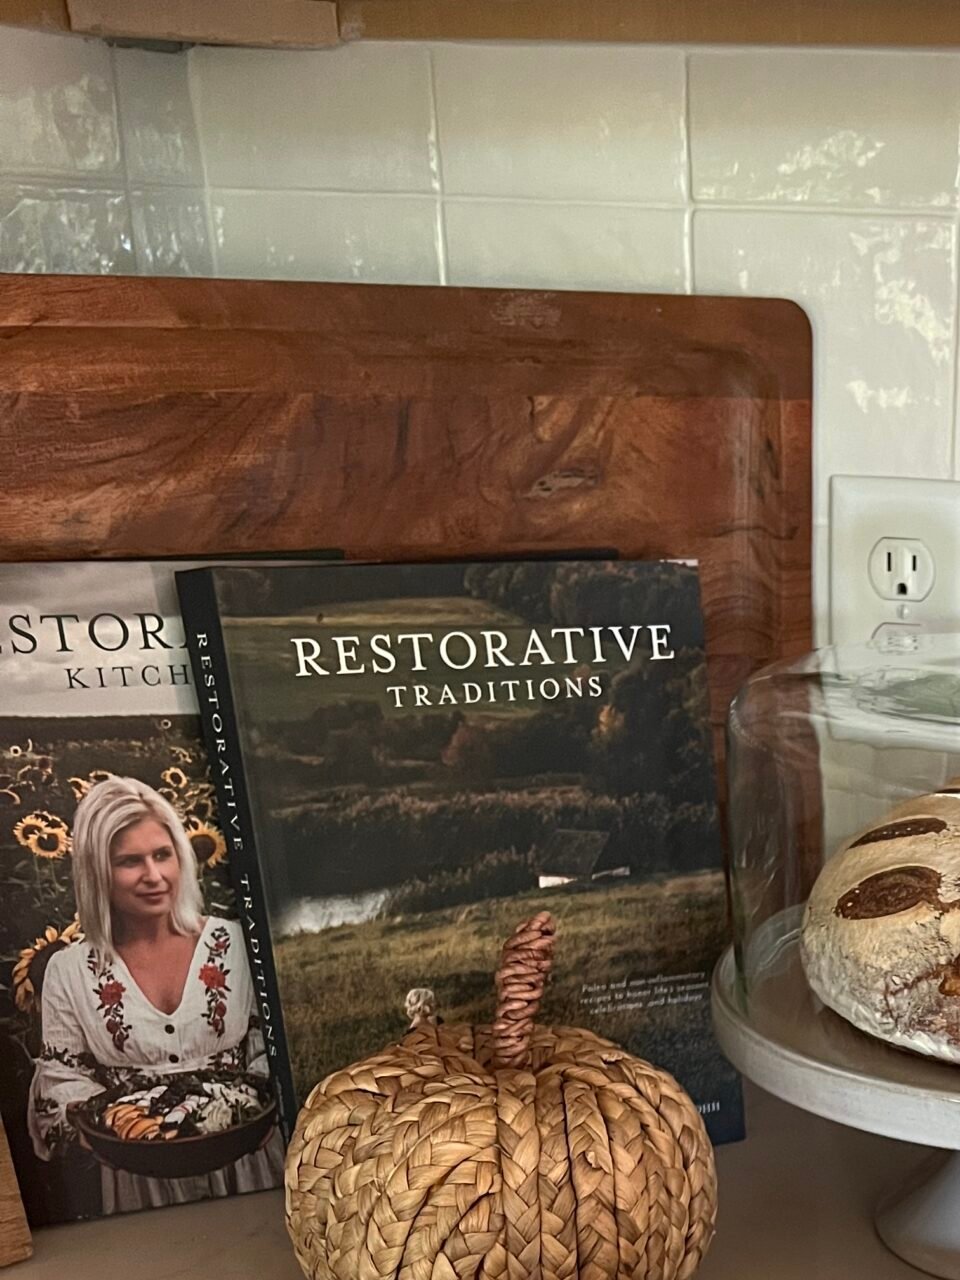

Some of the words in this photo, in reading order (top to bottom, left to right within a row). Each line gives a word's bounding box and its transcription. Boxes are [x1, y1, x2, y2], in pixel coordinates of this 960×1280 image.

[0, 612, 188, 654] STOR
[290, 624, 675, 677] RESTORATIVE
[64, 664, 192, 689] KITCH
[386, 676, 602, 707] TRADITIONS
[196, 633, 243, 850] RESTORATIVE
[240, 873, 277, 1057] TRADITIONS
